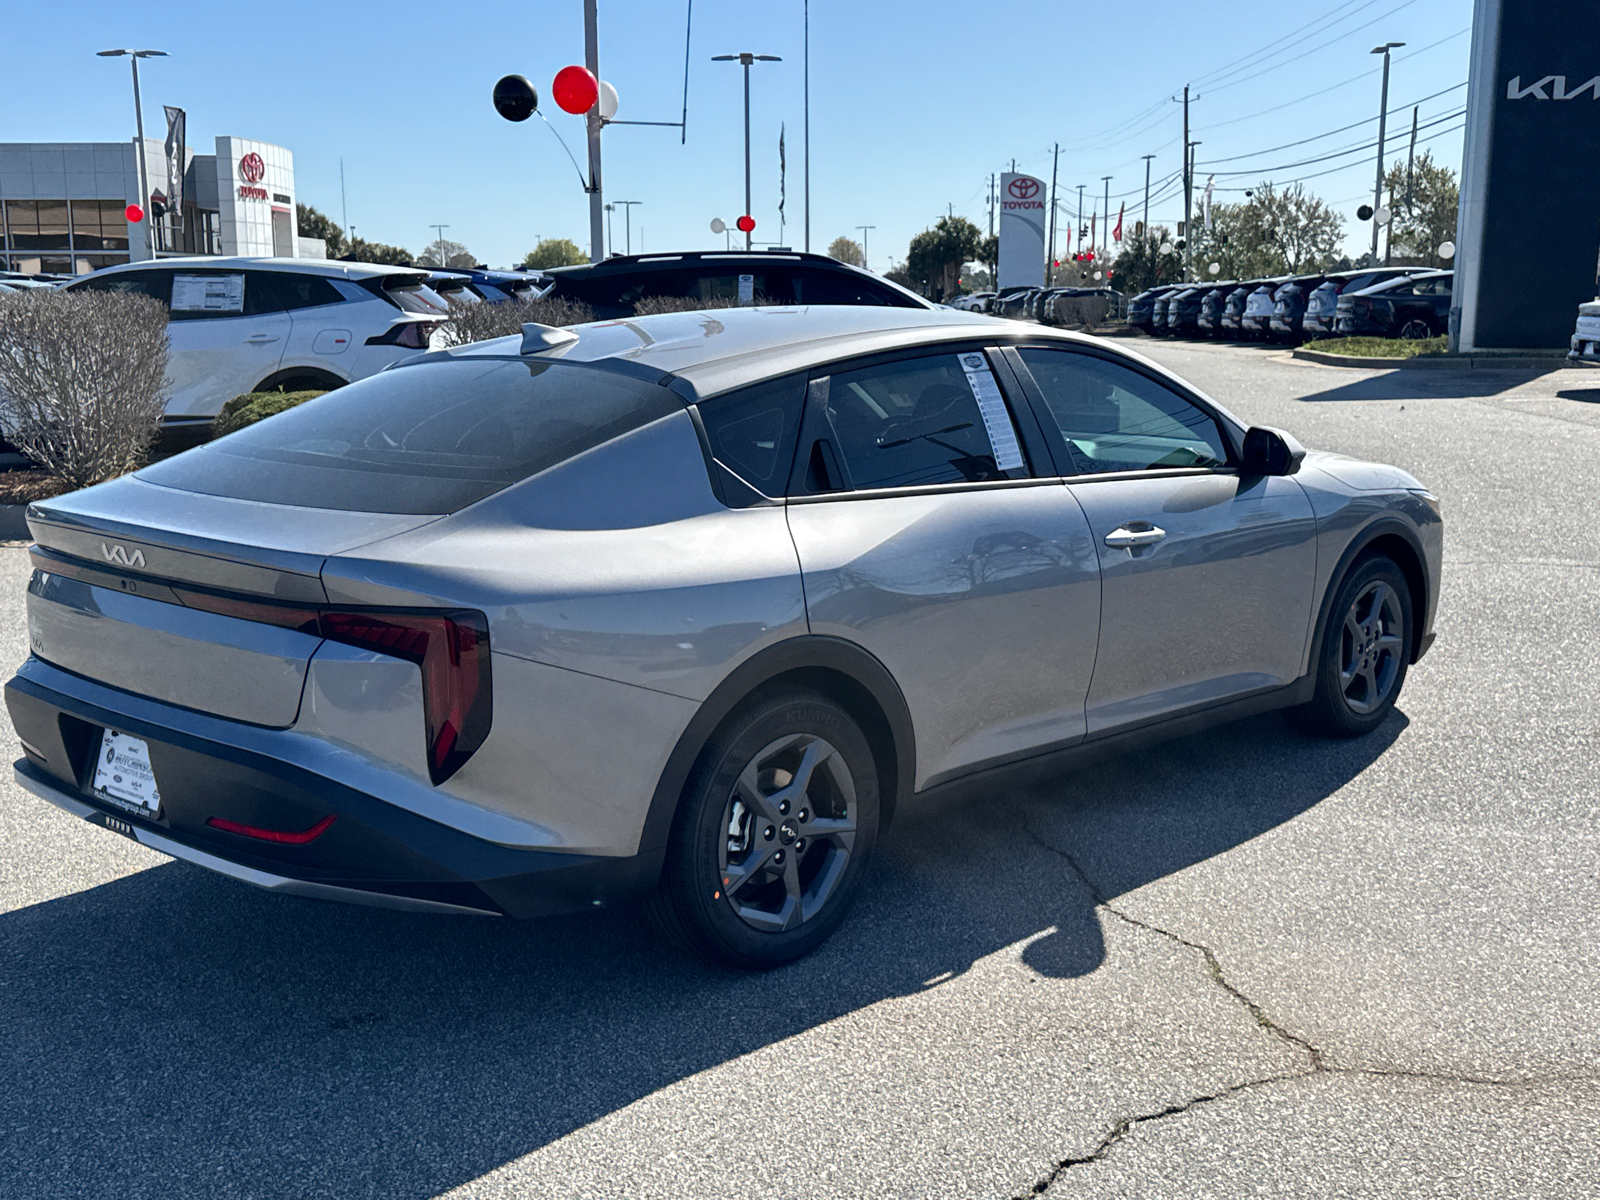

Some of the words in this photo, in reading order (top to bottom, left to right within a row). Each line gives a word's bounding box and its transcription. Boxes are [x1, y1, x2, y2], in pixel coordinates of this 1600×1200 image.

[240, 186, 269, 200] TOYOTA
[1002, 201, 1044, 210] TOYOTA
[101, 541, 147, 568] KIA
